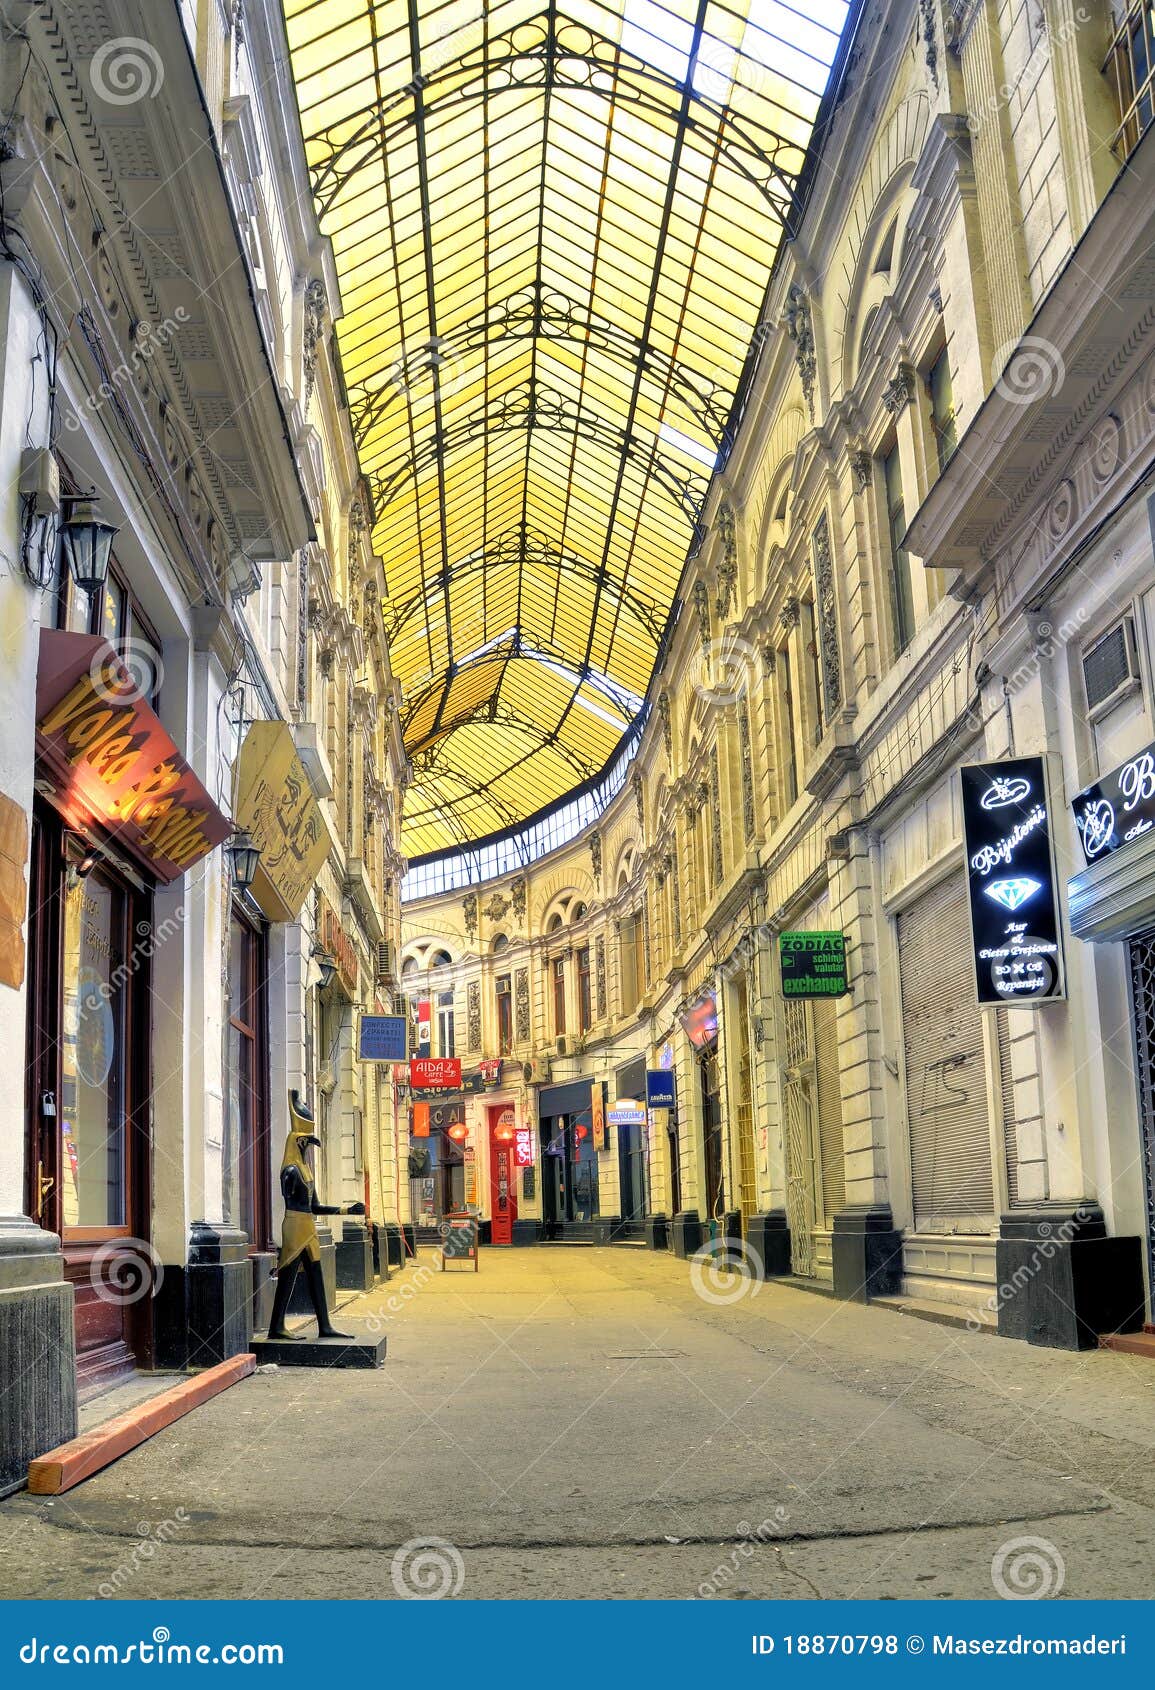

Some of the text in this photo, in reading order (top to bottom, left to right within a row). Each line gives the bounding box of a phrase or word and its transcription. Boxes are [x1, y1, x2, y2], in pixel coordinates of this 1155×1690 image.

[41, 666, 143, 785] Valea
[971, 804, 1047, 875] Bijuterii
[1004, 922, 1028, 934] Aur
[782, 939, 843, 951] ZODIAC
[812, 952, 844, 963] schimb
[814, 963, 844, 973] valutar
[783, 973, 845, 993] exchange
[416, 1062, 444, 1072] AIDA
